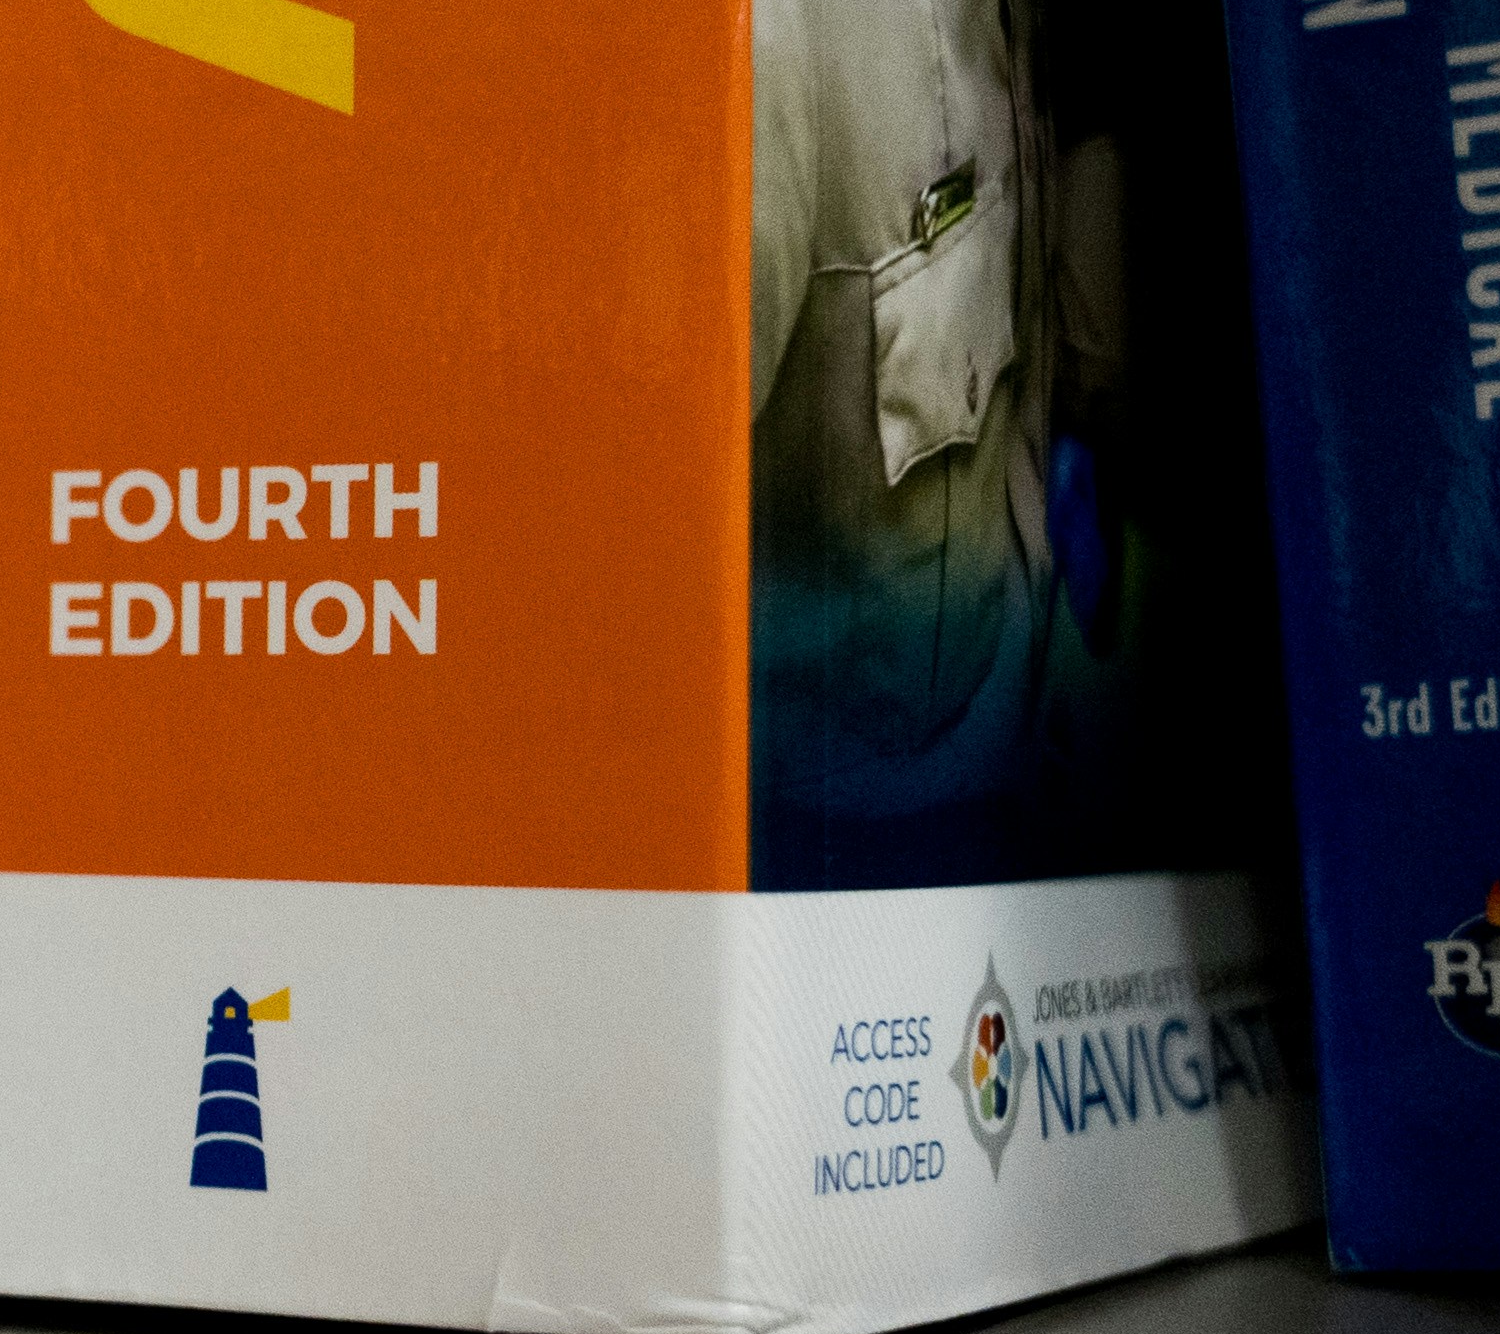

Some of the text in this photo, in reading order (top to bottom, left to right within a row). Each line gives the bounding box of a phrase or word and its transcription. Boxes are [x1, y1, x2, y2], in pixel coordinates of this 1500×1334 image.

[50, 461, 439, 545] FOURTH
[49, 579, 438, 656] EDITION
[1361, 682, 1433, 738] 3rd
[1033, 980, 1083, 1023] JONES
[1083, 978, 1098, 1016] &
[829, 1013, 933, 1065] ACCESS
[843, 1078, 921, 1129] CODE
[813, 1138, 946, 1196] INCLUDED
